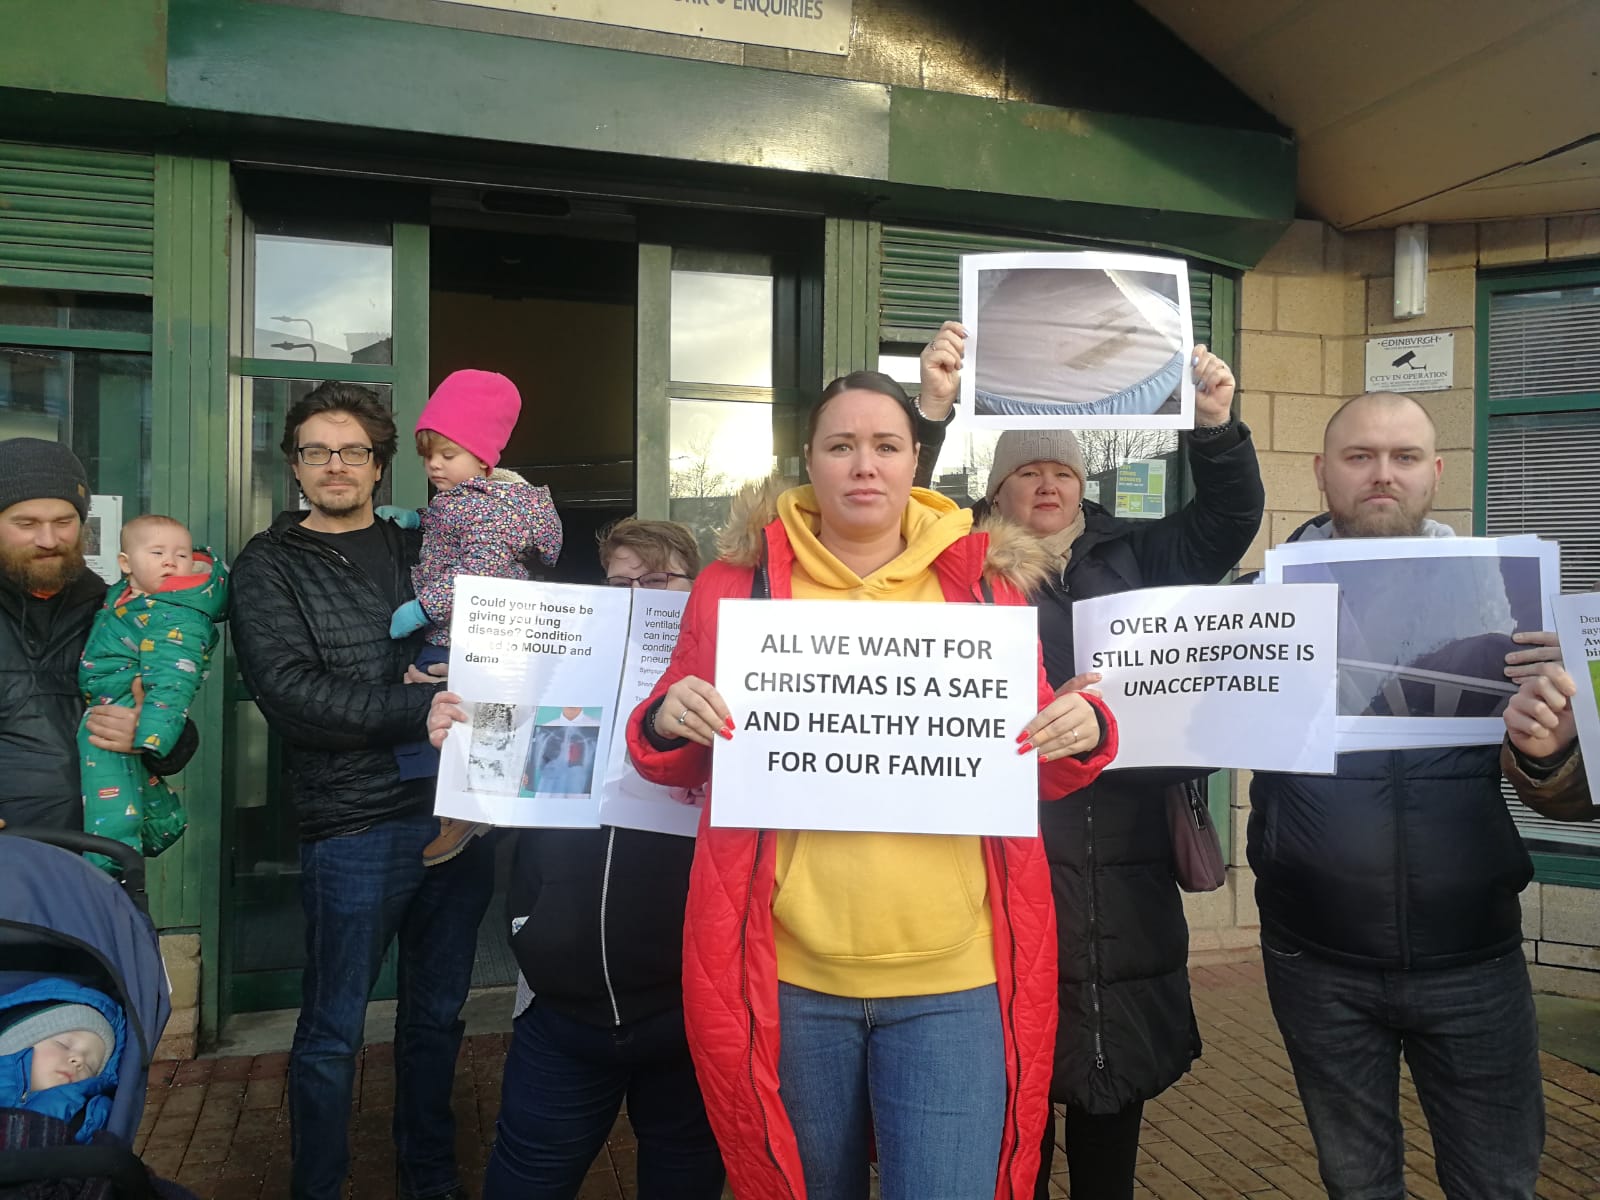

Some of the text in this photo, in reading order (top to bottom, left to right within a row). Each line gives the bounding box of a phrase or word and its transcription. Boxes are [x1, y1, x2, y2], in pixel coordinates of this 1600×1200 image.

[734, 0, 823, 19] ENQUIRIES
[1403, 371, 1447, 380] OPERATION
[470, 596, 594, 615] Could your house be
[646, 608, 680, 618] If mould
[469, 610, 561, 628] giving you lung
[1110, 612, 1296, 636] OVER A YEAR AND
[468, 624, 582, 642] disease? Condition
[643, 632, 680, 642] can incr
[522, 643, 567, 655] MOULD
[570, 646, 592, 656] and
[760, 633, 993, 660] ALL WE WANT FOR
[1092, 643, 1315, 669] STILL NO RESPONSE IS
[641, 655, 671, 664] pneum
[744, 672, 1009, 699] CHRISTMAS IS A SAFE
[1123, 675, 1280, 697] UNACCEPTABLE
[744, 711, 1006, 739] AND HEALTHY HOME
[768, 751, 982, 778] FOR OUR FAMILY
